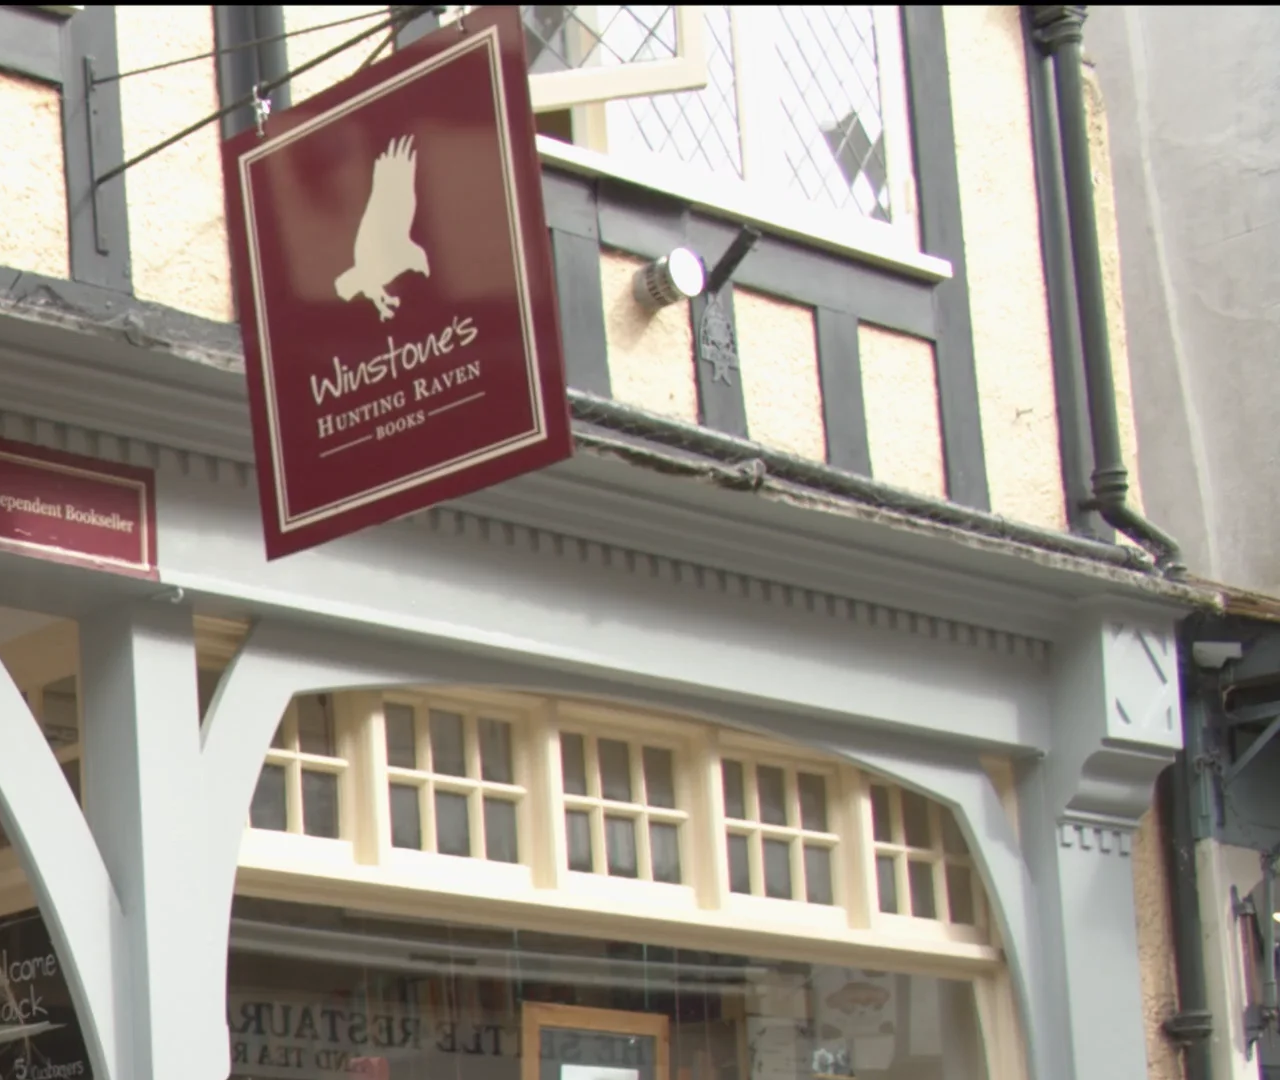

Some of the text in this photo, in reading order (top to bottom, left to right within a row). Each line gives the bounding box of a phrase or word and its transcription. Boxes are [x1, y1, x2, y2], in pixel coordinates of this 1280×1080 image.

[310, 315, 478, 405] Winstone's
[317, 360, 482, 440] HUNTING RAVEN
[375, 410, 426, 441] BOOKS
[65, 505, 135, 533] Bookseller
